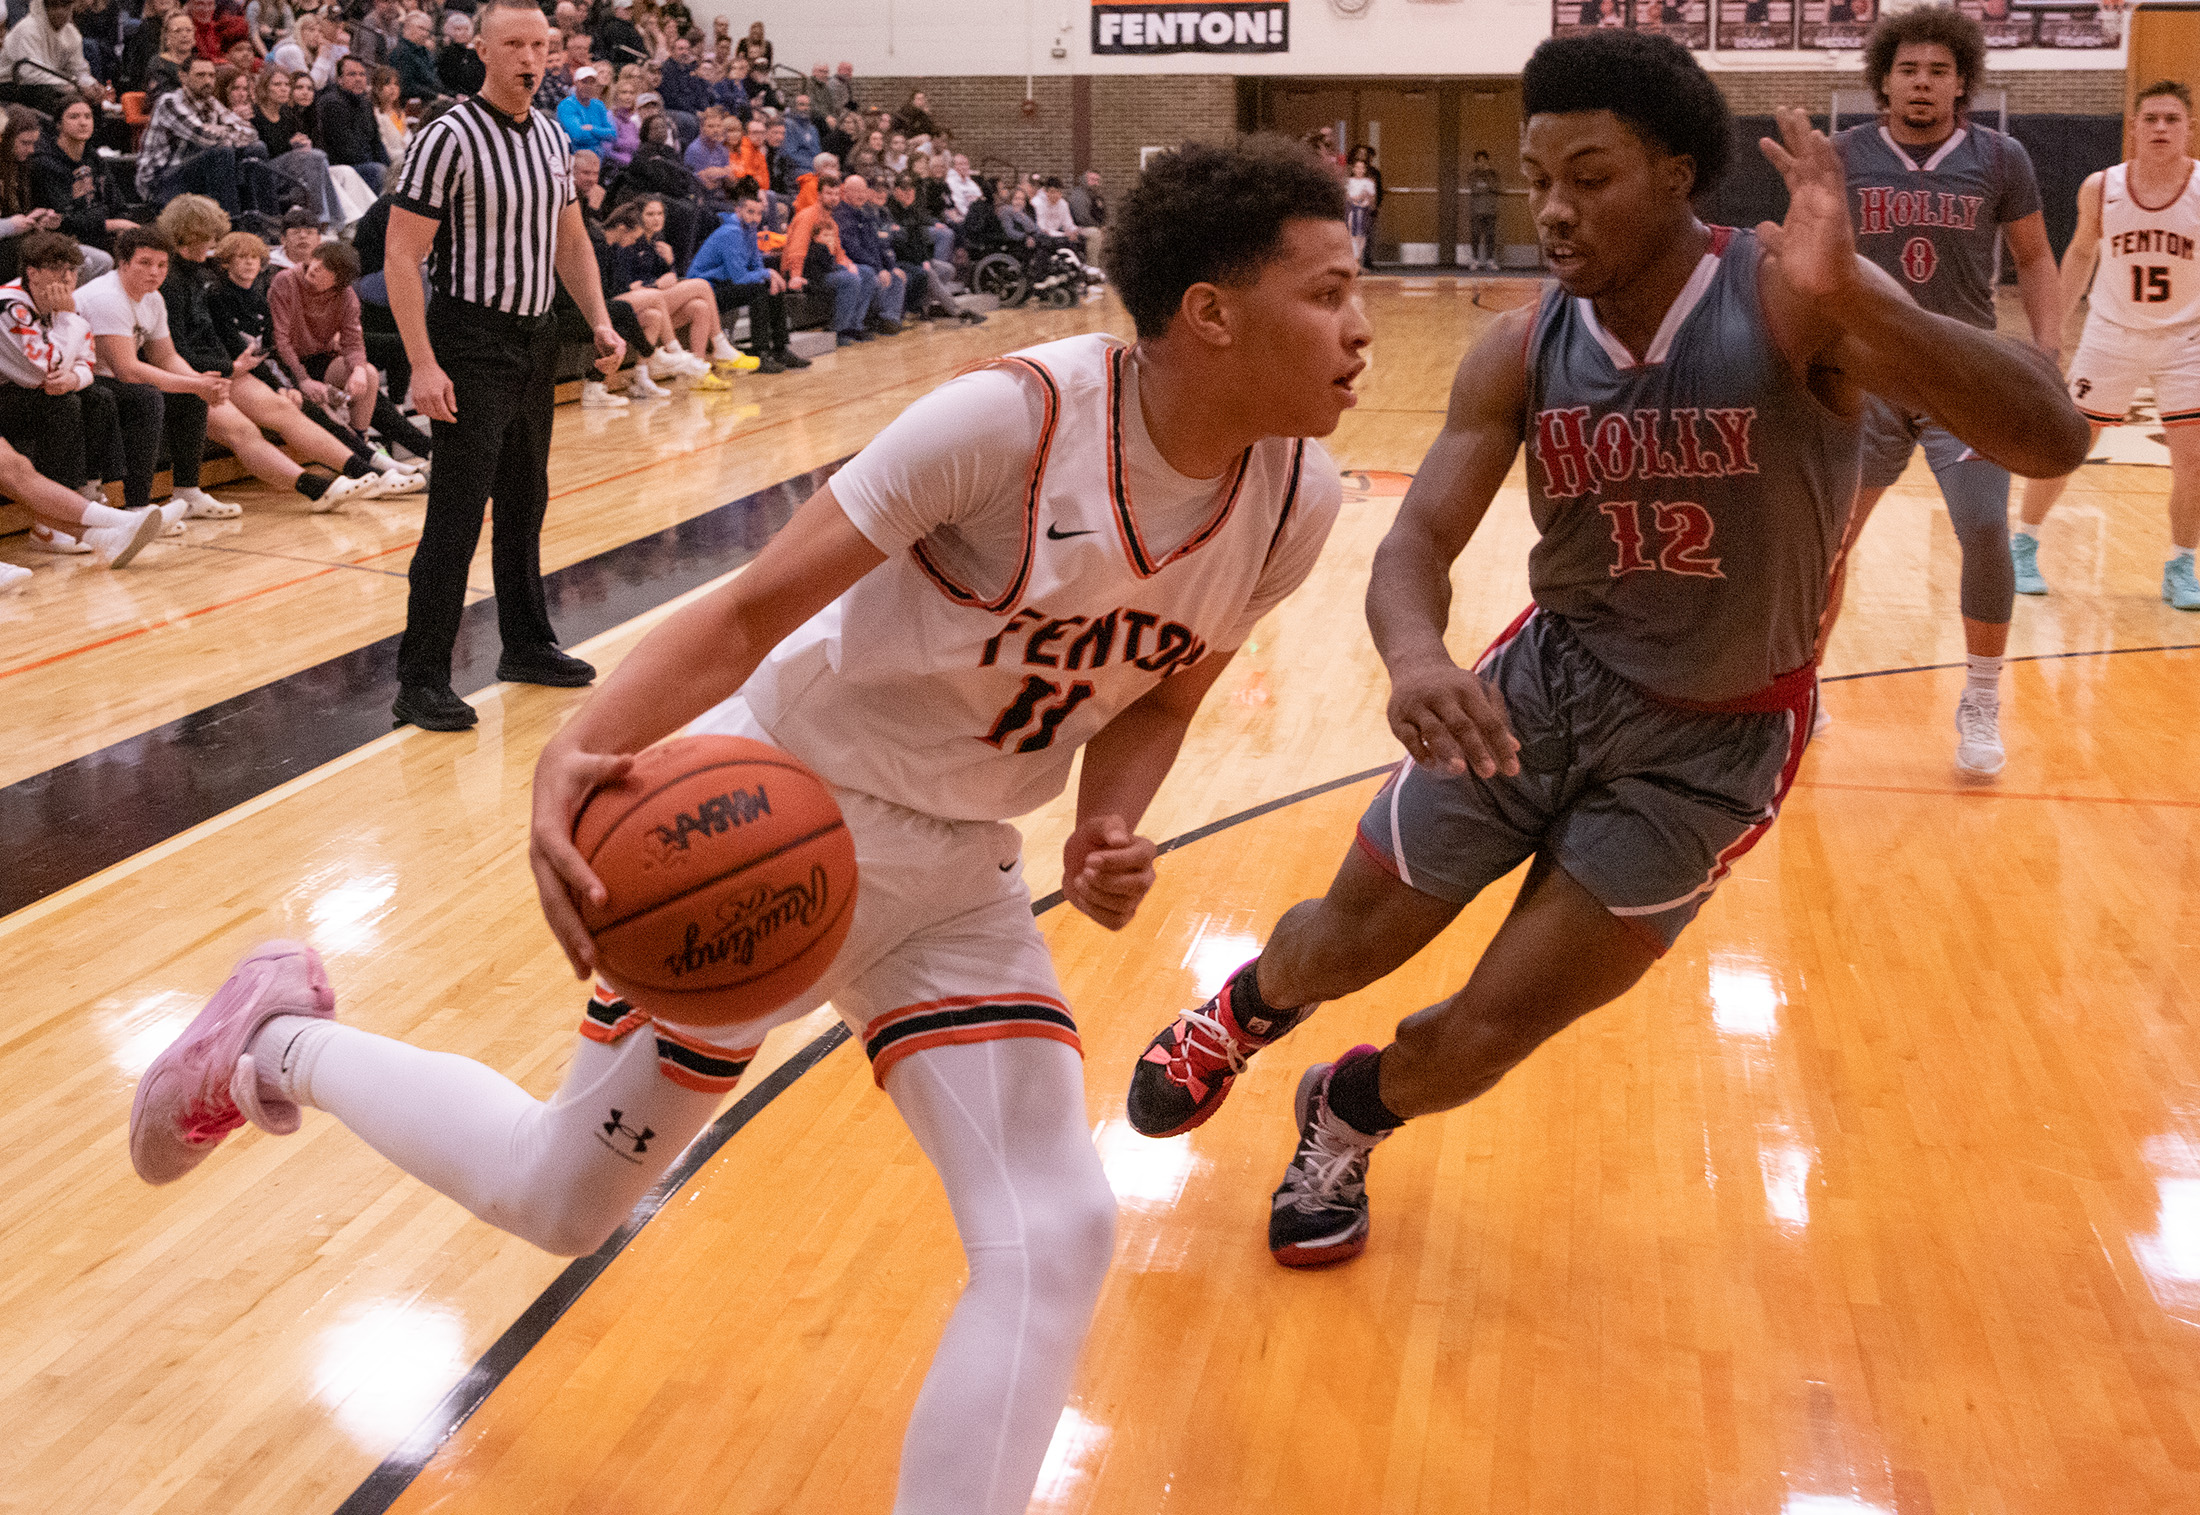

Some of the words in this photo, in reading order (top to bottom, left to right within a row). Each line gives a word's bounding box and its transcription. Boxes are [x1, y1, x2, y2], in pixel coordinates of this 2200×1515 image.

[1100, 9, 1282, 46] FENTON!
[1857, 186, 1984, 235] HOLLY
[2110, 229, 2195, 260] FENTON
[2131, 265, 2171, 303] 15
[1535, 406, 1759, 498] HOLLY
[1599, 500, 1726, 578] 12
[973, 673, 1095, 753] 11
[664, 863, 827, 976] Rawlings
